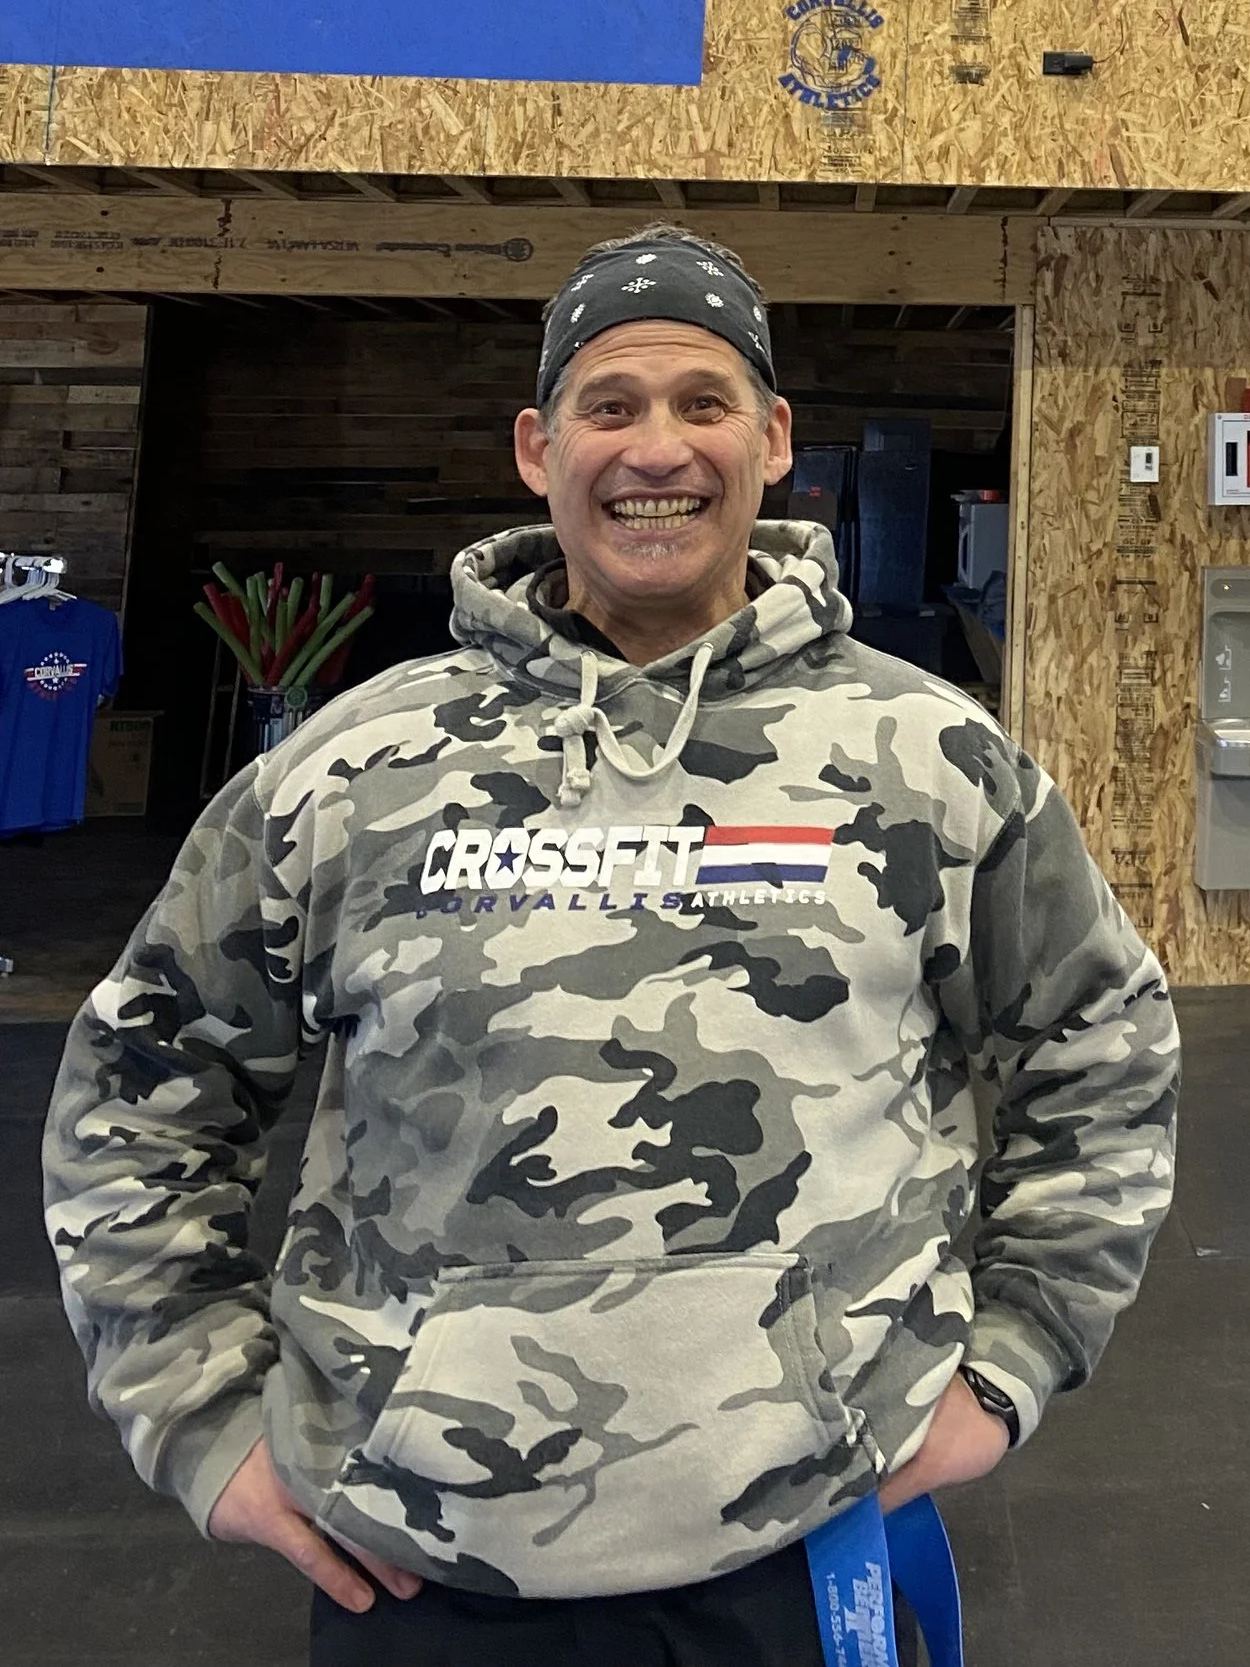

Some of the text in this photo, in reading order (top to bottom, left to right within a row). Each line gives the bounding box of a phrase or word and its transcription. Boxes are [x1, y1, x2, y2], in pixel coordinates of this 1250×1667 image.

[778, 73, 881, 110] ATHLETICS
[420, 825, 705, 895] CROSSFIT
[691, 888, 828, 908] ATHLETICS
